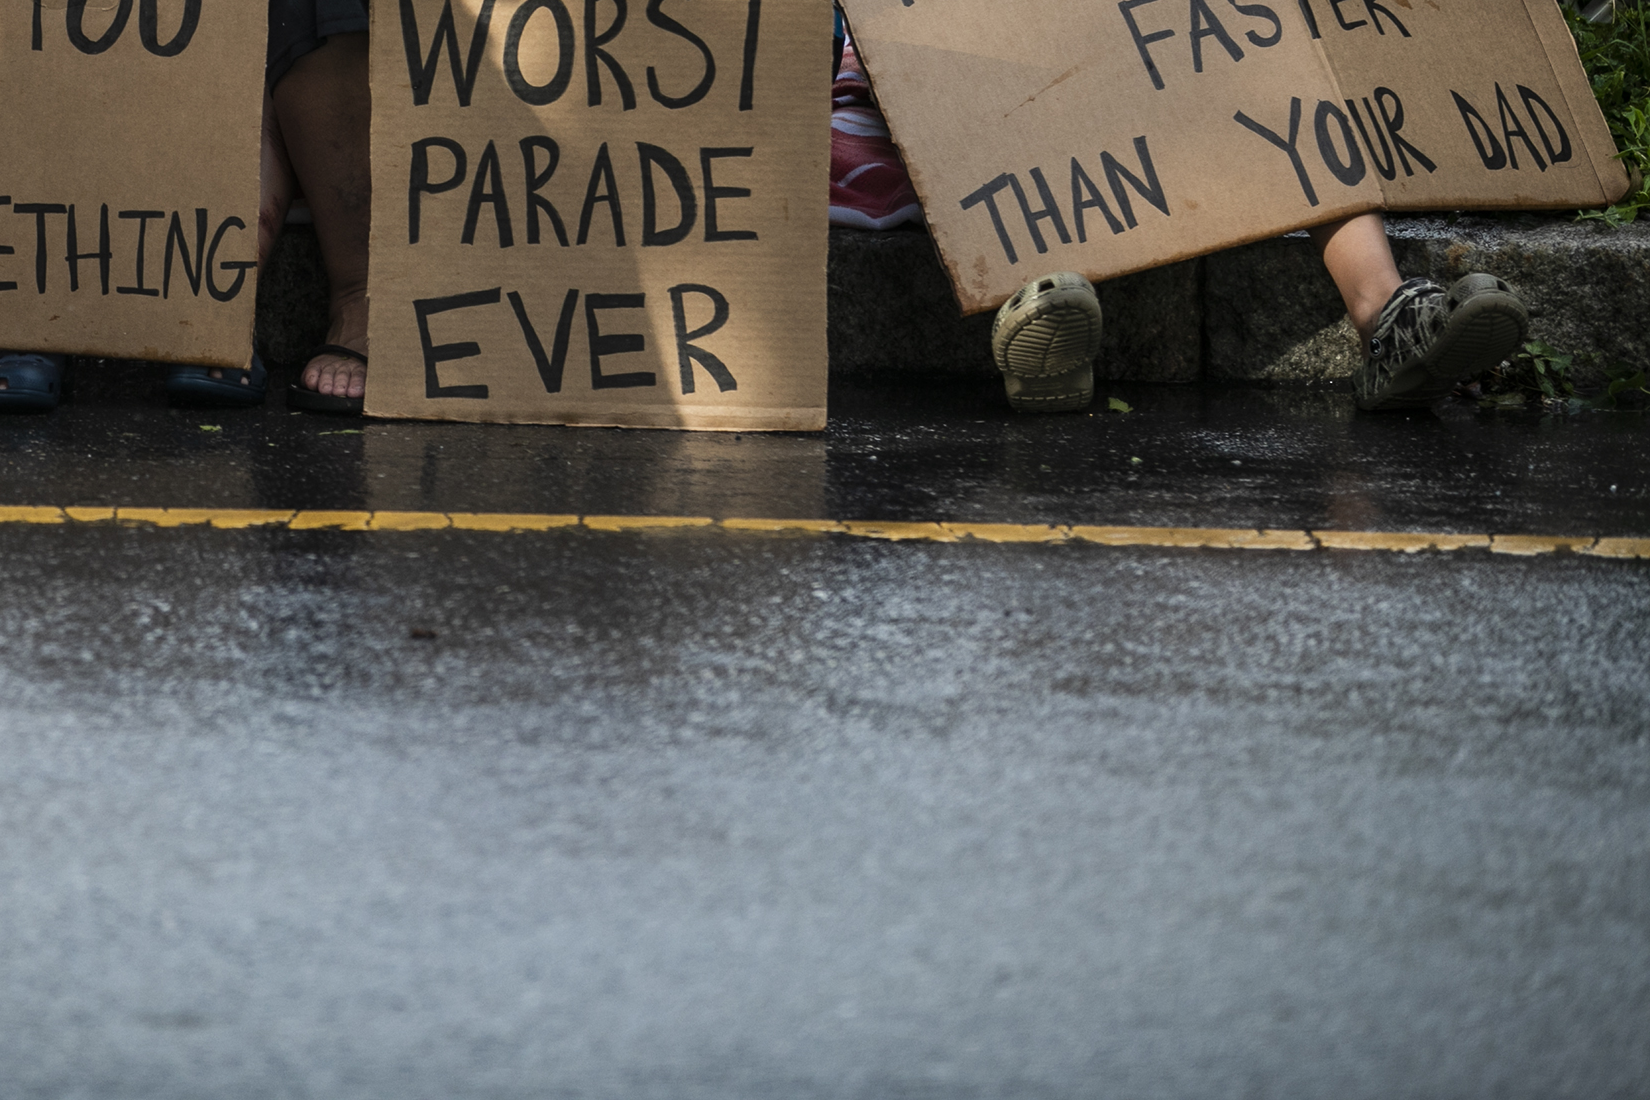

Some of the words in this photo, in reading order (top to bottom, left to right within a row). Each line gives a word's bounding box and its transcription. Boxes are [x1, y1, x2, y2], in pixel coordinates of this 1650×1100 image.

[408, 134, 759, 249] PARADE
[959, 136, 1171, 265] THAN
[1233, 86, 1437, 207] YOUR
[1449, 81, 1573, 173] DAD
[412, 282, 738, 400] EVER
